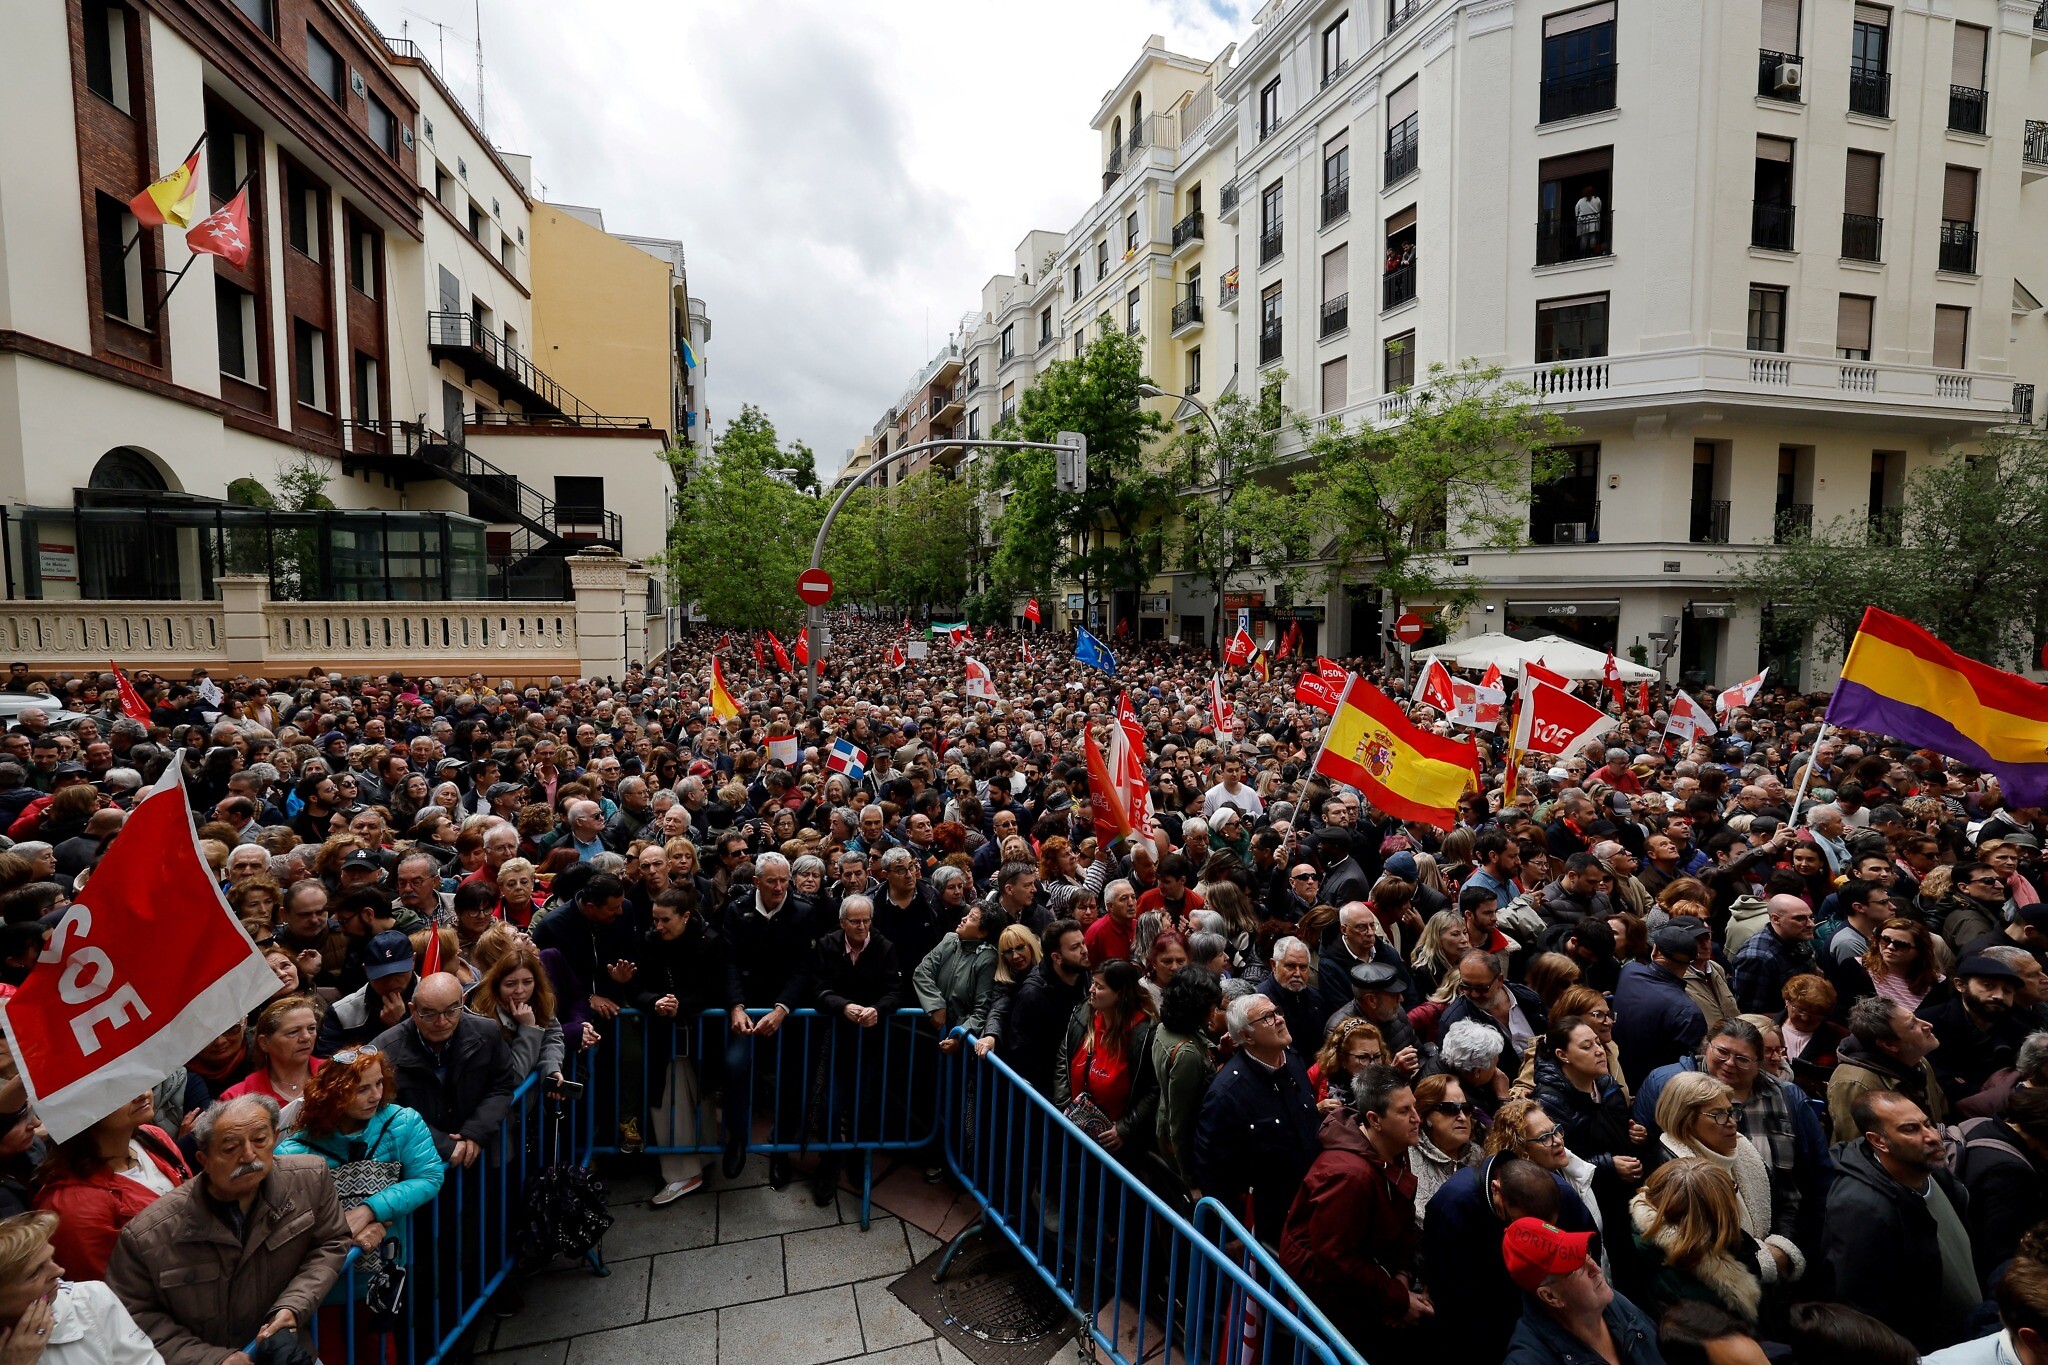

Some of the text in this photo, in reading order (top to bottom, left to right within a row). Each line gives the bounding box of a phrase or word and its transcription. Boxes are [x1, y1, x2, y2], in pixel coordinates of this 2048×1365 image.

[1303, 681, 1324, 693] PSOE
[37, 903, 152, 1057] SOE
[1513, 1228, 1584, 1261] PORTUGAL
